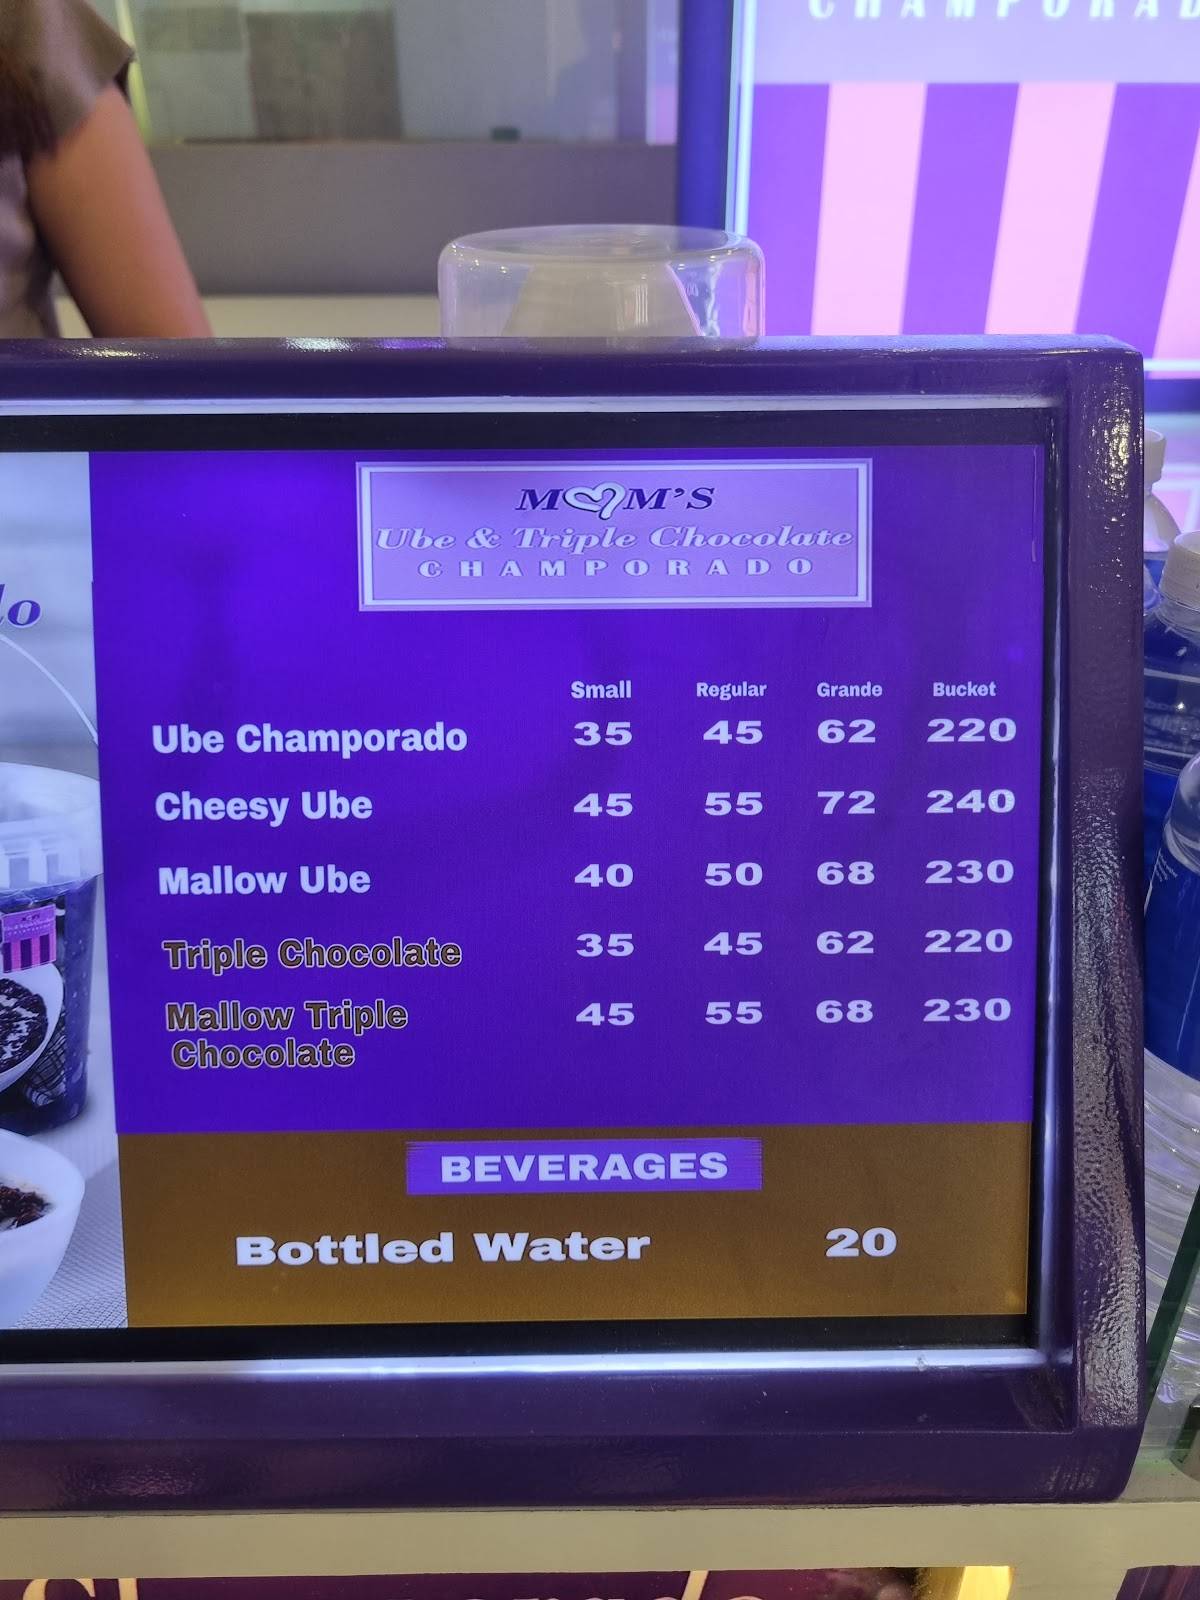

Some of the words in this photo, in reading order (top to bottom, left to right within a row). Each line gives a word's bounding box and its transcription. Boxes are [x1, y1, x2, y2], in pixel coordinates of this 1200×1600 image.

[375, 527, 456, 550] Ube
[465, 527, 501, 549] &
[513, 526, 637, 555] Triple
[649, 524, 853, 549] Chocolate
[418, 557, 814, 579] CHAMPORADO
[570, 680, 632, 699] Small
[696, 681, 767, 701] Regular
[816, 681, 883, 698] Grande
[932, 681, 997, 698] Bucket
[152, 724, 225, 754] Ube
[236, 722, 468, 759] Champorado
[575, 722, 632, 745] 35
[703, 720, 763, 744] 45
[817, 719, 876, 743] 62
[927, 718, 1017, 742] 220
[155, 791, 290, 827] Cheesy
[301, 790, 373, 819] Ube
[574, 793, 633, 816] 45
[704, 792, 763, 815] 55
[817, 791, 876, 814] 72
[926, 790, 1016, 813] 240
[159, 866, 288, 895] Mallow
[300, 864, 371, 893] Ube
[574, 864, 634, 887] 40
[705, 863, 763, 886] 50
[817, 861, 875, 885] 68
[925, 860, 1014, 883] 230
[162, 938, 268, 976] Triple
[278, 936, 463, 969] Chocolate
[576, 934, 634, 957] 35
[704, 932, 763, 955] 45
[816, 931, 874, 954] 62
[924, 929, 1013, 952] 220
[166, 1000, 295, 1031] Mallow
[304, 999, 409, 1036] Triple
[575, 1003, 634, 1026] 45
[705, 1001, 763, 1024] 55
[816, 1000, 874, 1023] 68
[923, 998, 1012, 1021] 230
[172, 1037, 356, 1069] Chocolate
[440, 1152, 729, 1183] BEVERAGES
[236, 1232, 454, 1266] Bottled
[473, 1232, 651, 1262] Water
[825, 1227, 898, 1257] 20
